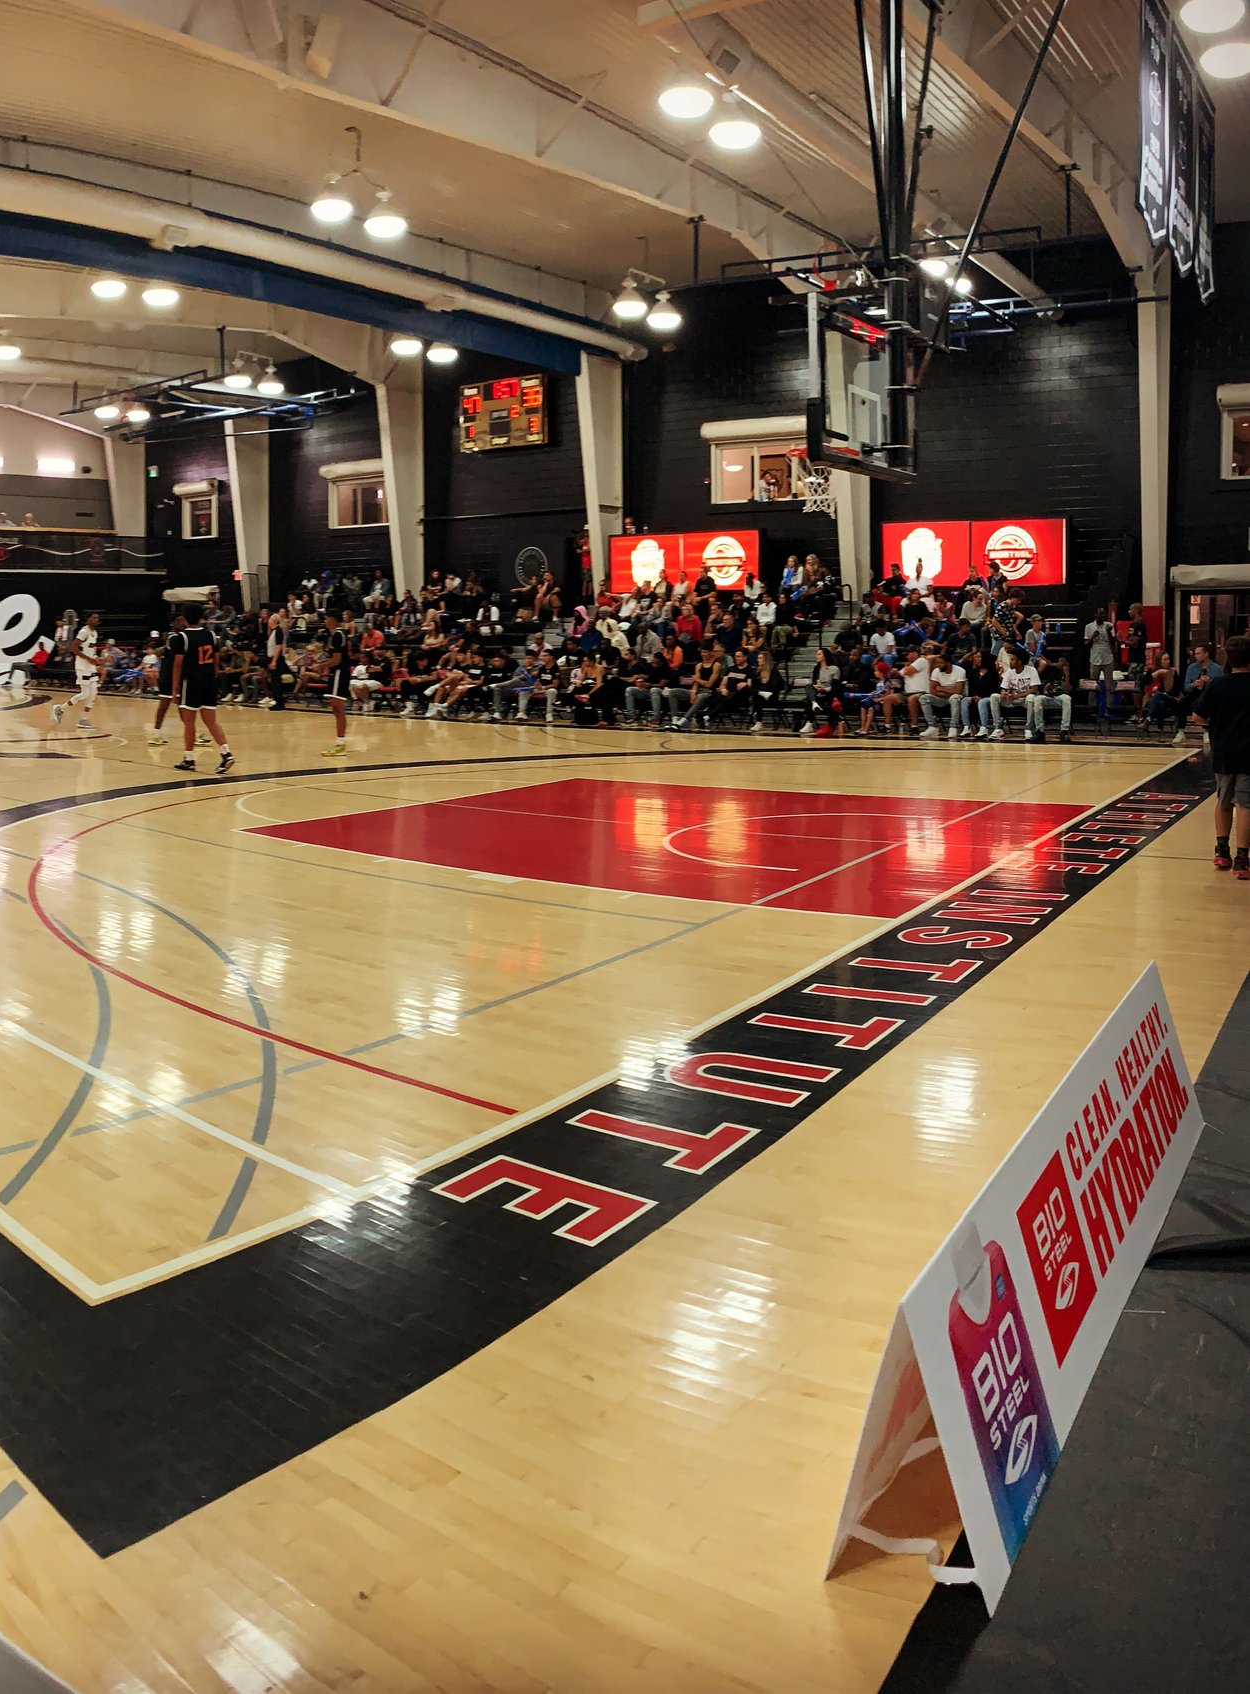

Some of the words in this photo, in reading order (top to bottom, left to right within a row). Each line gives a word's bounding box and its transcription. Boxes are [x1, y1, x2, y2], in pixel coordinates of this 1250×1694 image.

[463, 395, 481, 413] 47
[510, 404, 519, 418] 2
[530, 418, 538, 433] 3
[989, 551, 1033, 559] BIOSTEEL
[198, 645, 213, 664] 12
[1012, 791, 1200, 875] ATHLETE
[429, 888, 1071, 1247] INSTITUTE
[1066, 1078, 1121, 1181] CLEAN.
[1115, 1002, 1168, 1100] HEALTHY.
[1080, 1046, 1189, 1279] HYDRATION.
[1032, 1187, 1066, 1260] BIO
[1043, 1231, 1073, 1281] STEEL
[971, 1311, 1021, 1424] BIO
[989, 1375, 1030, 1450] STEEL
